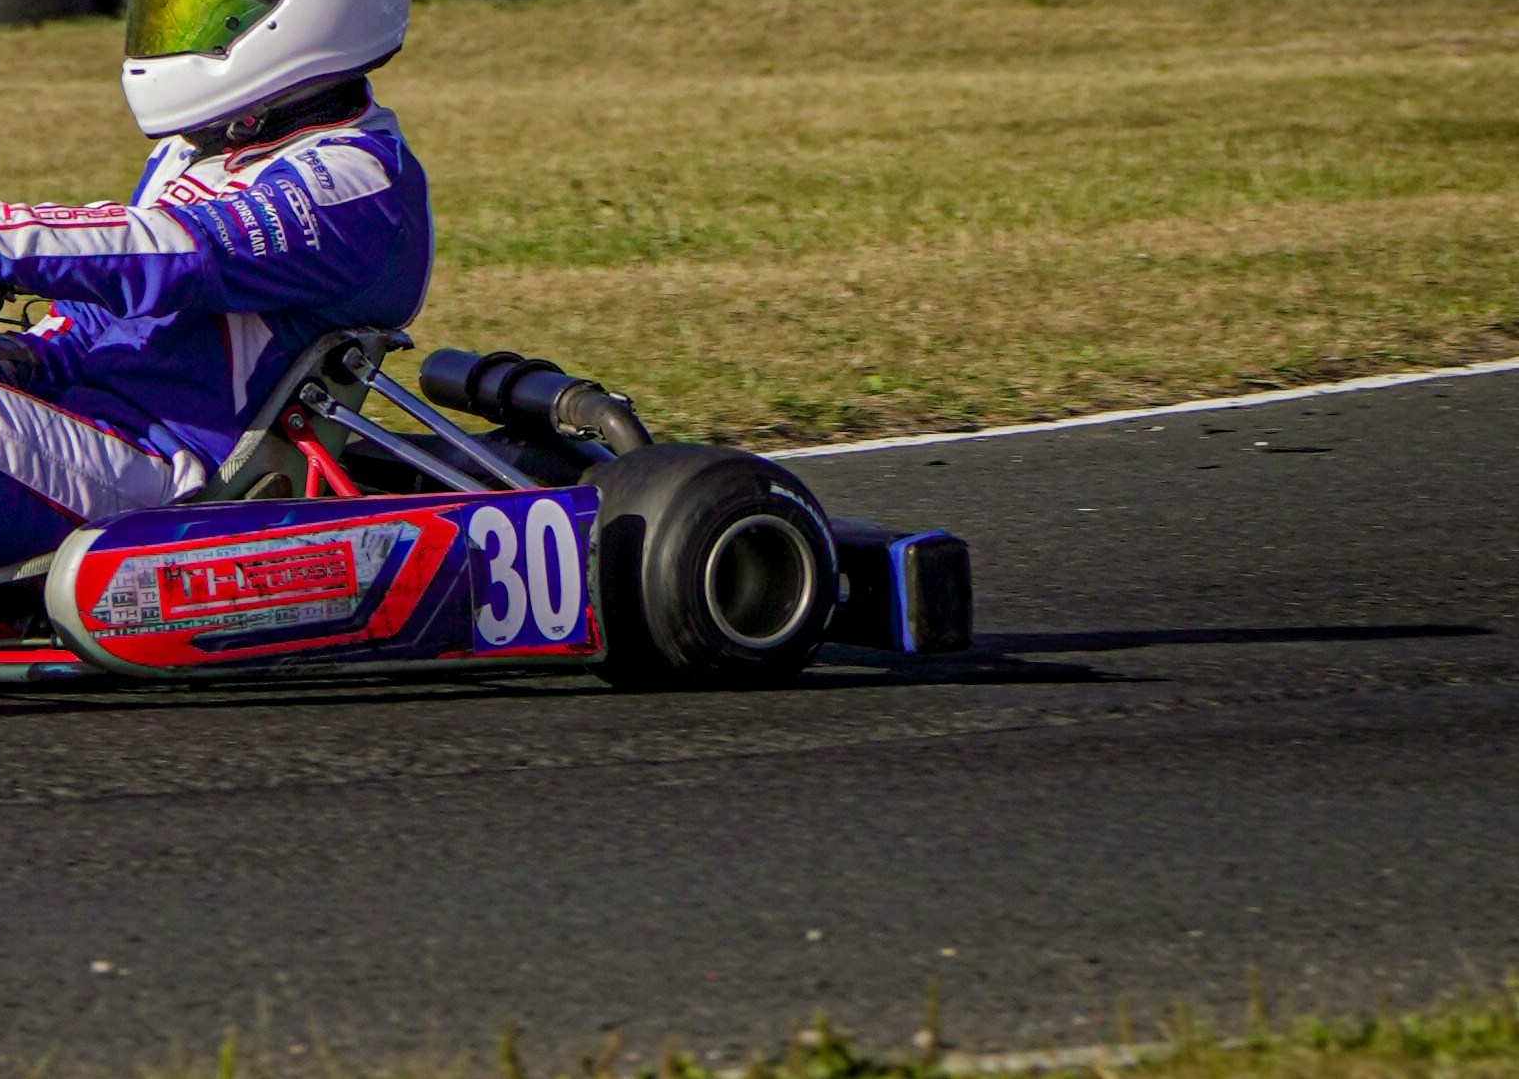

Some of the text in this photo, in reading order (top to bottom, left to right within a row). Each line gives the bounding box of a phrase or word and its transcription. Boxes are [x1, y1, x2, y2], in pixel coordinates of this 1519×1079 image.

[231, 199, 258, 229] CORSE
[247, 226, 268, 257] KART
[468, 498, 581, 645] 30
